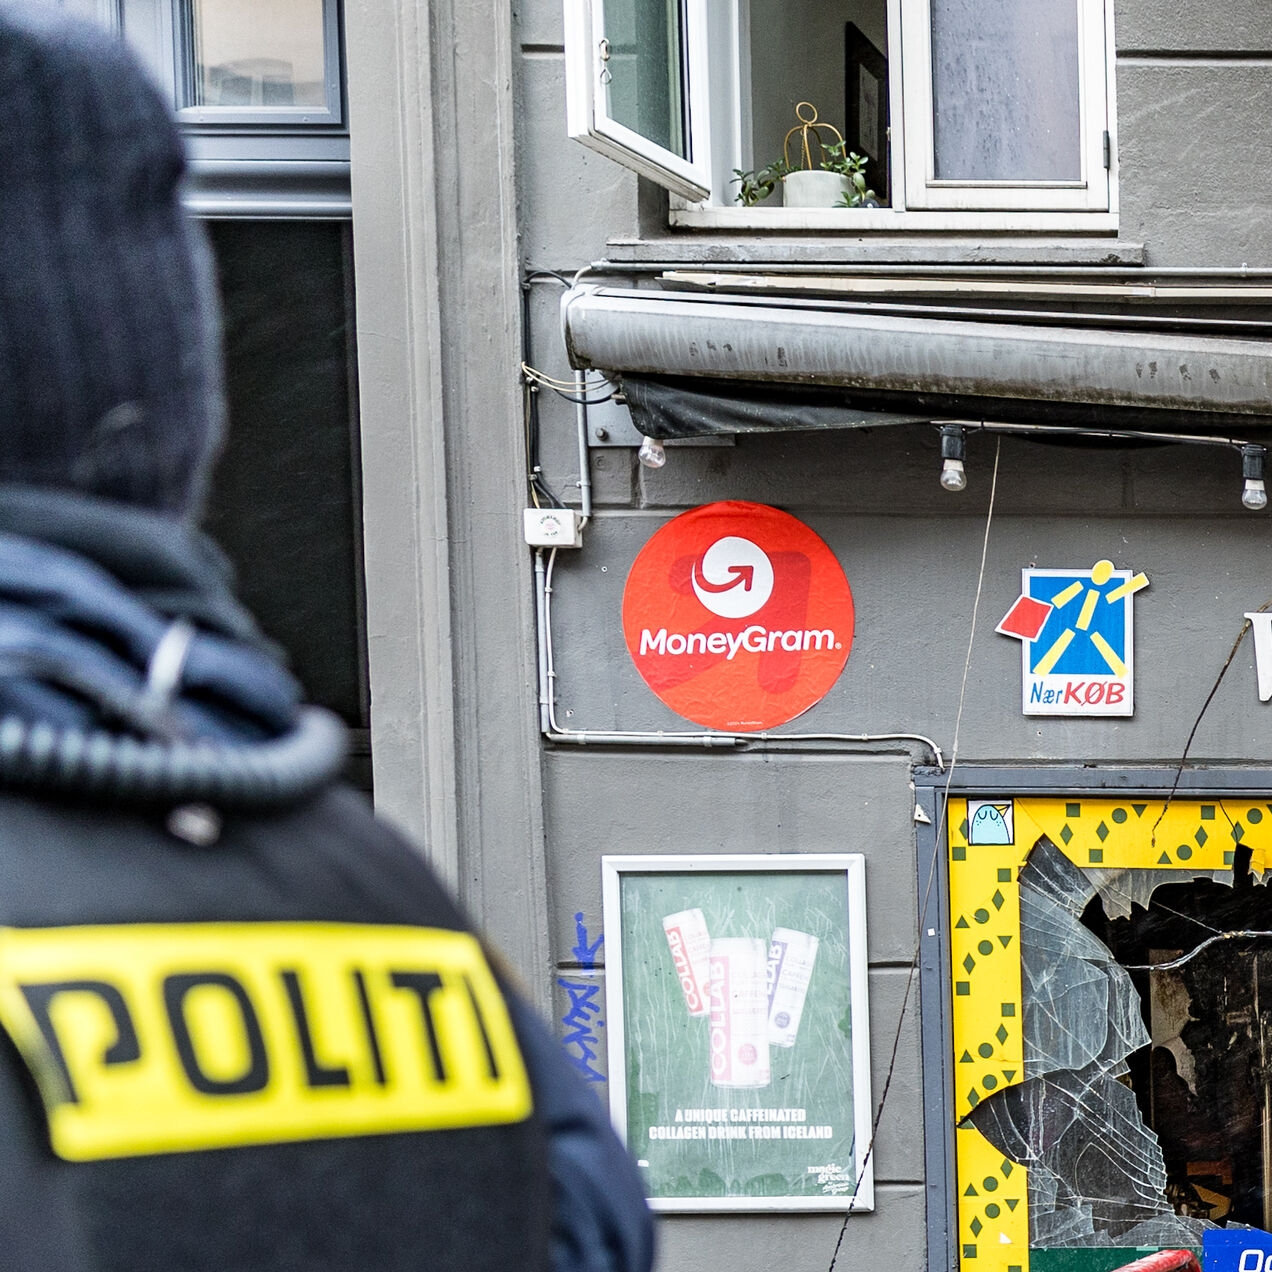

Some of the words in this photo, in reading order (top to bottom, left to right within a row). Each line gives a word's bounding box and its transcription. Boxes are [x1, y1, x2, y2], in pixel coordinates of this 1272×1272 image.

[640, 625, 835, 661] MoneyGram
[16, 968, 501, 1110] POLITI
[675, 1108, 682, 1122] A
[684, 1108, 728, 1124] UNIQUE
[730, 1108, 807, 1122] CAFFEINATED
[649, 1126, 707, 1140] COLLAGEN
[708, 1126, 748, 1139] DRINK
[749, 1126, 782, 1139] FROM
[783, 1125, 833, 1139] ICELAND
